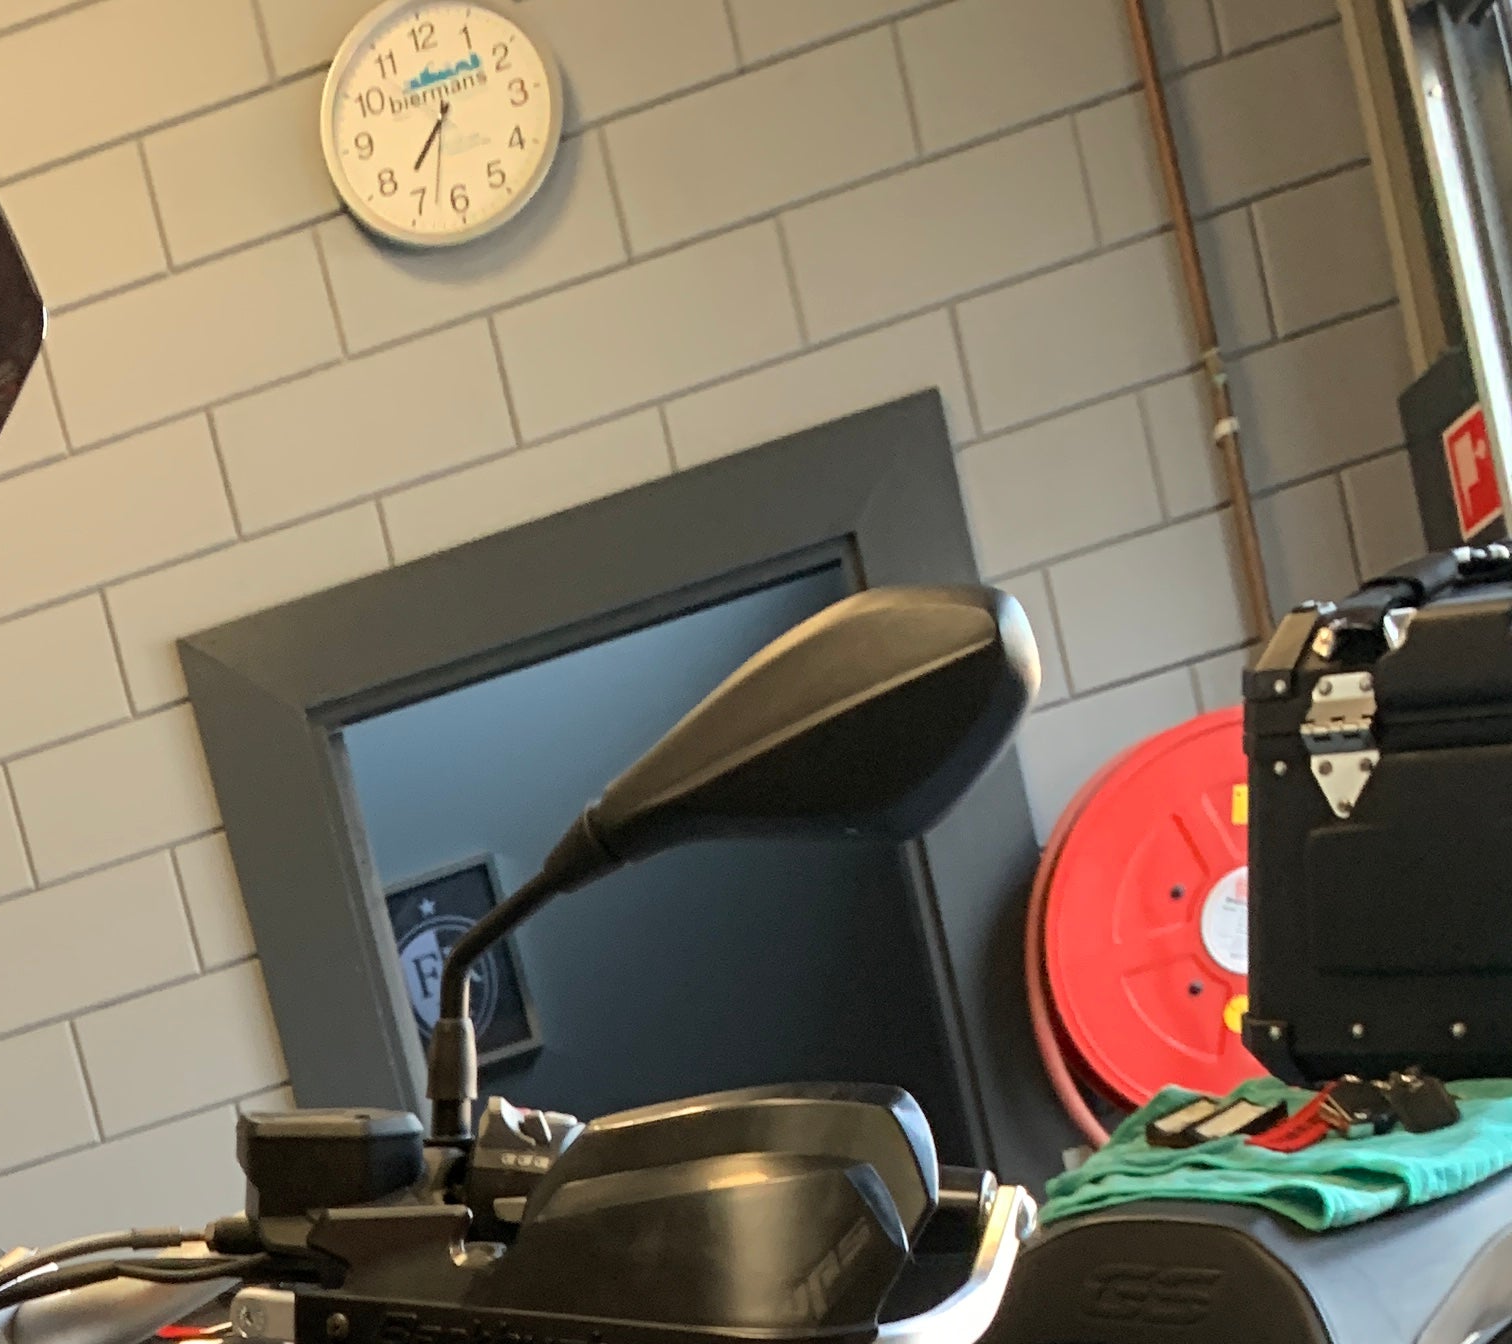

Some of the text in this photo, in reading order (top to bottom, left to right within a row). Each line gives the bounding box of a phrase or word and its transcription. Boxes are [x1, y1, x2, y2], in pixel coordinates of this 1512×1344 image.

[408, 22, 438, 51] 12
[460, 25, 472, 49] 1
[375, 51, 397, 79] 11
[492, 42, 511, 72] 2
[354, 87, 385, 118] 10
[389, 70, 487, 114] biermans
[508, 78, 529, 107] 3
[354, 132, 374, 160] 9
[508, 125, 525, 150] 4
[377, 168, 398, 197] 8
[487, 160, 506, 188] 5
[410, 187, 427, 216] 7
[450, 184, 469, 213] 6
